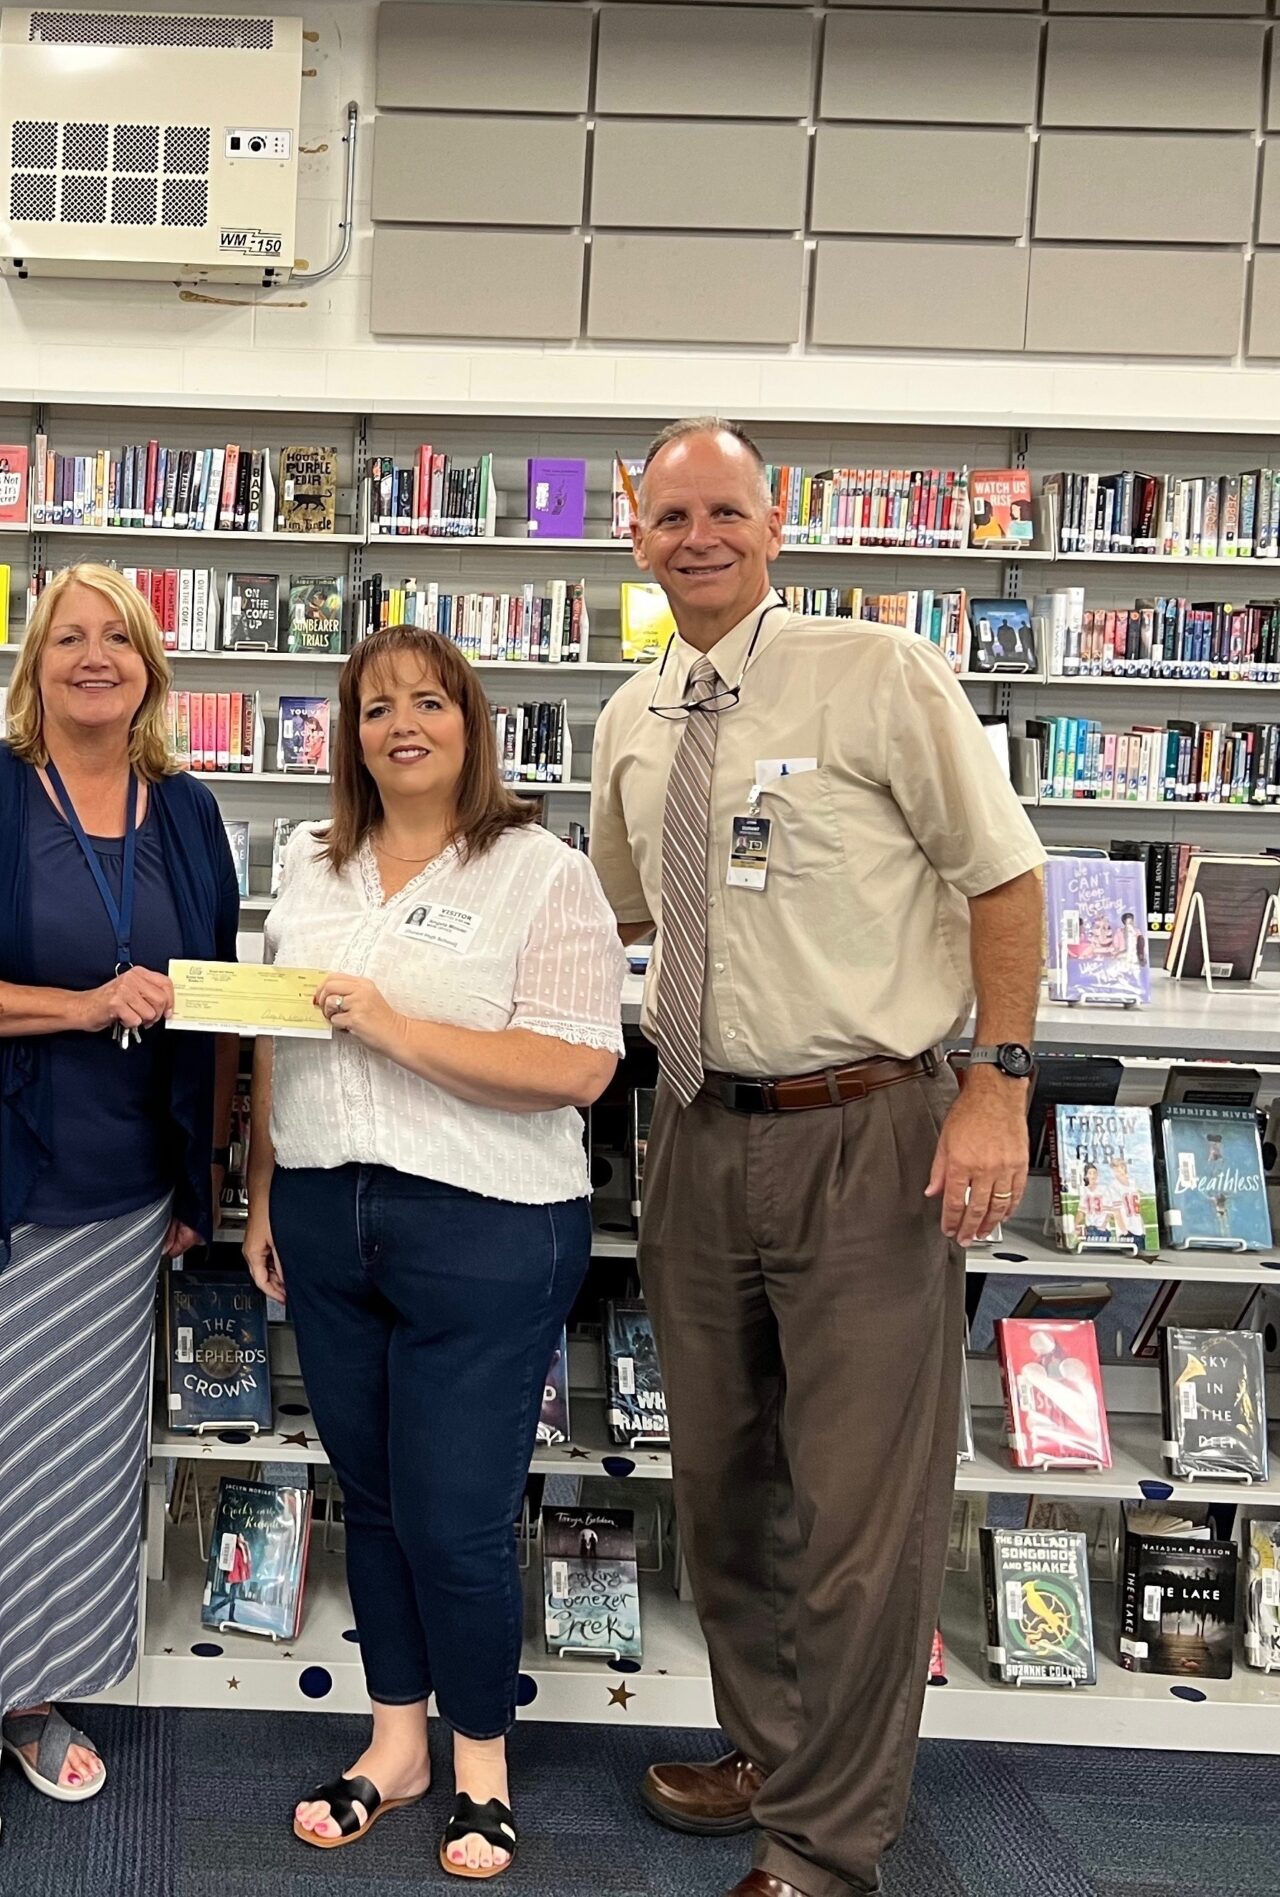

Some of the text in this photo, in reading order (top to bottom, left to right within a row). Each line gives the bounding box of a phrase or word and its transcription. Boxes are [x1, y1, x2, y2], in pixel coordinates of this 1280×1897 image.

[221, 233, 247, 247] WM
[286, 462, 332, 474] PURPLE
[250, 468, 261, 511] BADD
[975, 481, 1027, 494] WATCH US
[990, 495, 1012, 507] RISE
[244, 588, 260, 598] ON
[250, 599, 269, 609] THE
[181, 606, 189, 626] COME
[196, 606, 204, 626] COME
[245, 610, 275, 619] COME
[249, 620, 262, 630] UP
[302, 633, 329, 647] TRIALS
[1068, 871, 1110, 893] CAN'T
[1078, 888, 1105, 902] Keep
[441, 908, 472, 922] VISITOR
[1166, 1107, 1256, 1119] JENNIFER NIVEN
[1065, 1115, 1138, 1137] THROW
[1086, 1195, 1102, 1215] 13
[203, 1317, 236, 1333] THE
[174, 1348, 267, 1364] SEPHERD'S
[1199, 1355, 1229, 1369] SKY
[183, 1373, 258, 1399] CROWN
[1206, 1381, 1224, 1395] IN
[1201, 1408, 1233, 1423] THE
[225, 1483, 279, 1496] JACLYN MORIARTY
[995, 1536, 1013, 1545] THE
[1013, 1535, 1068, 1548] BALLAD
[1001, 1548, 1077, 1561] SONGBIRDS
[1142, 1543, 1184, 1553] NATASHA
[1188, 1545, 1231, 1556] PRESTON
[1002, 1562, 1022, 1571] AND
[568, 1568, 623, 1589] rossing
[1182, 1588, 1220, 1601] LAKE
[1125, 1572, 1136, 1633] THE LAKE
[1006, 1664, 1088, 1679] SUZANNE COLLINS
